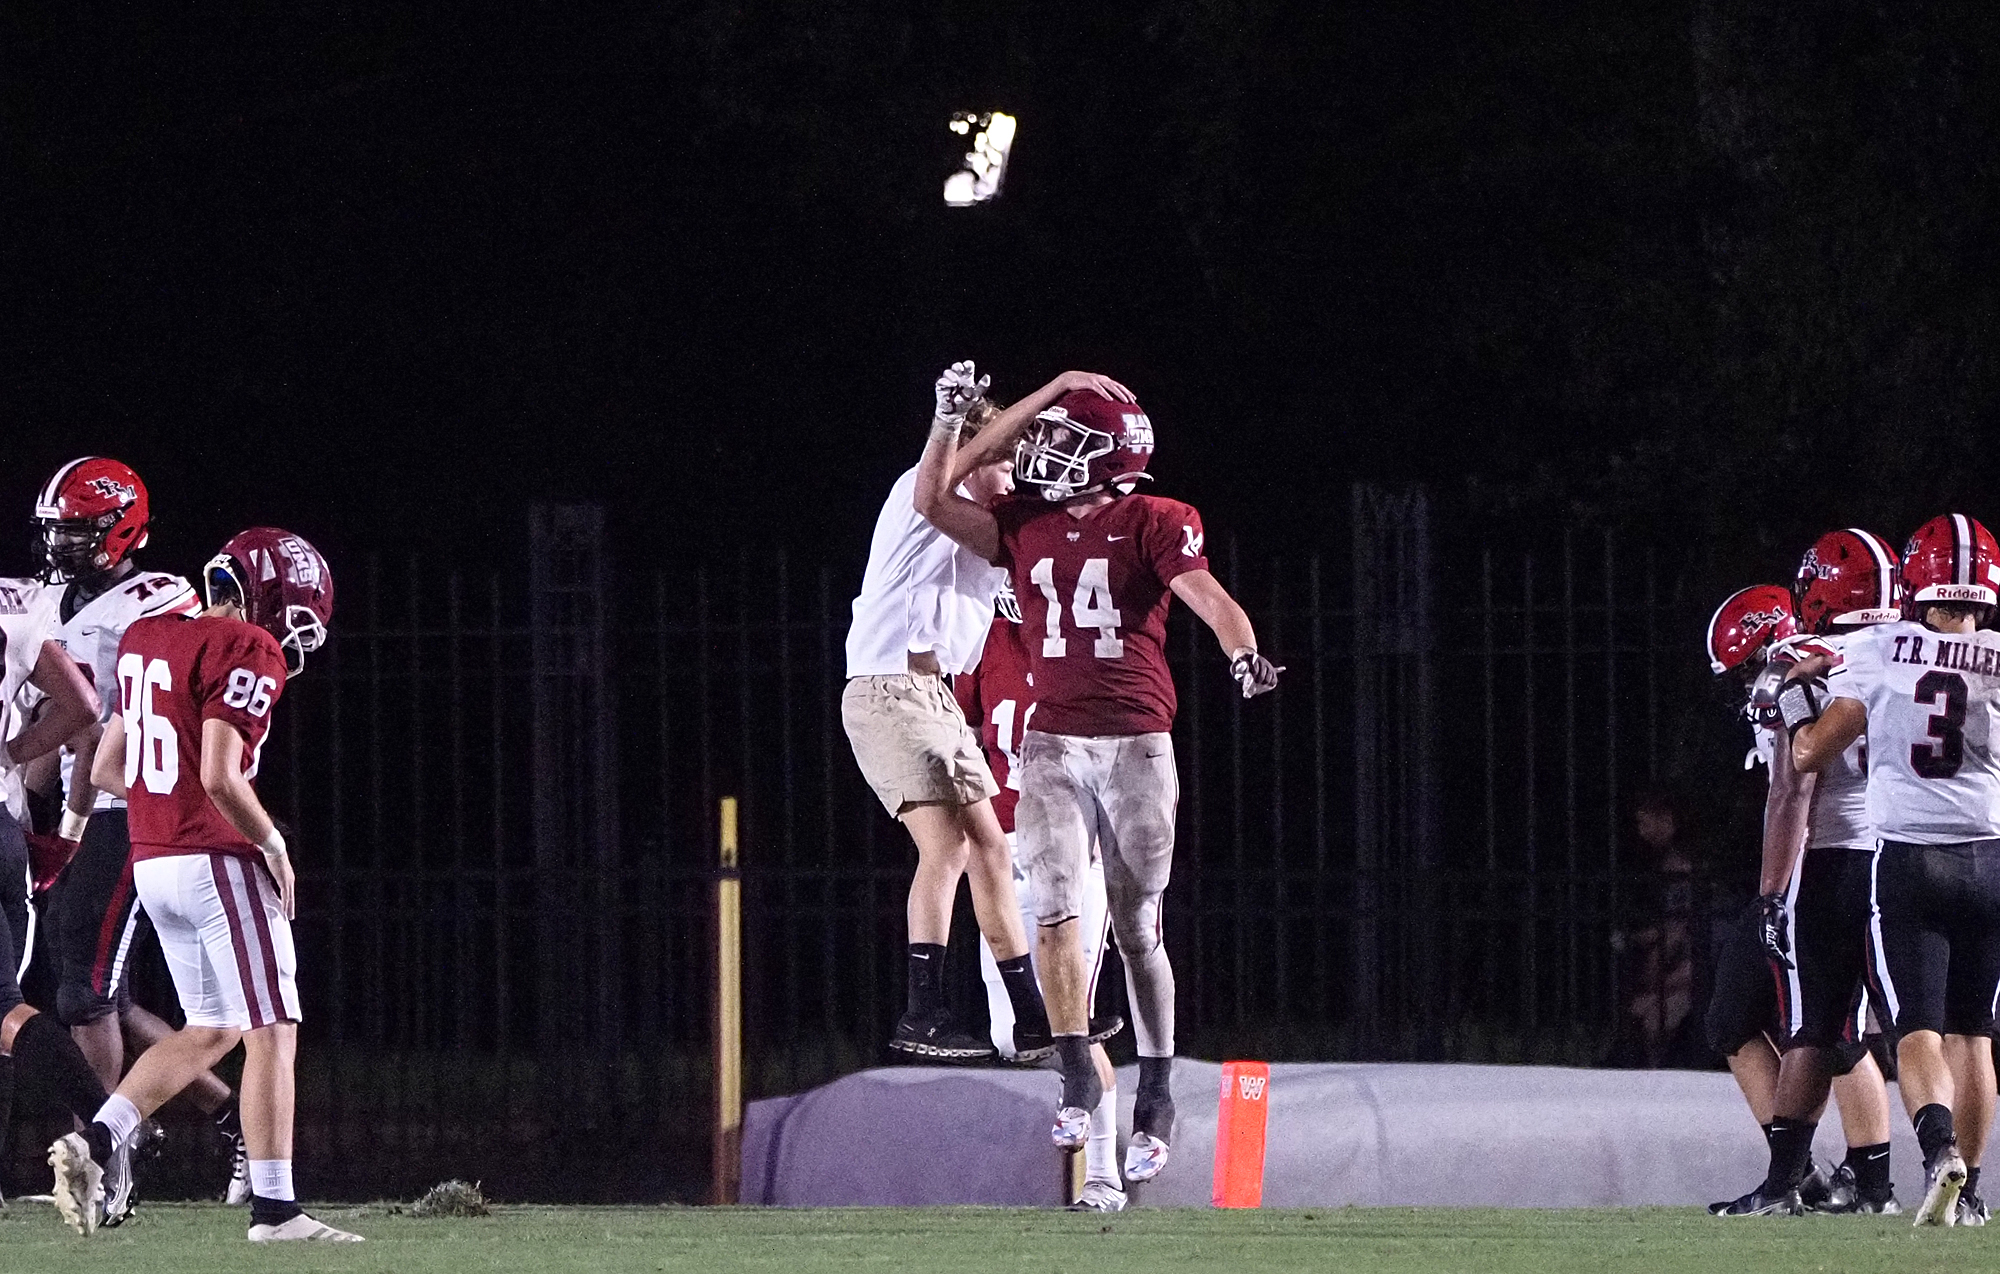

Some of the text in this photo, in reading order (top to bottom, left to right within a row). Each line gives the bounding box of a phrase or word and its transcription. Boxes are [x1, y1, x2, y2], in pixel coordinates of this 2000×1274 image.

[1181, 525, 1203, 557] 14
[1030, 557, 1124, 658] 14
[1936, 587, 1986, 601] Riddell
[1892, 636, 1928, 665] T.R.
[223, 668, 276, 718] 86
[118, 653, 178, 795] 86
[991, 699, 1037, 790] 1
[1911, 670, 1968, 778] 3
[1238, 1076, 1266, 1100] W
